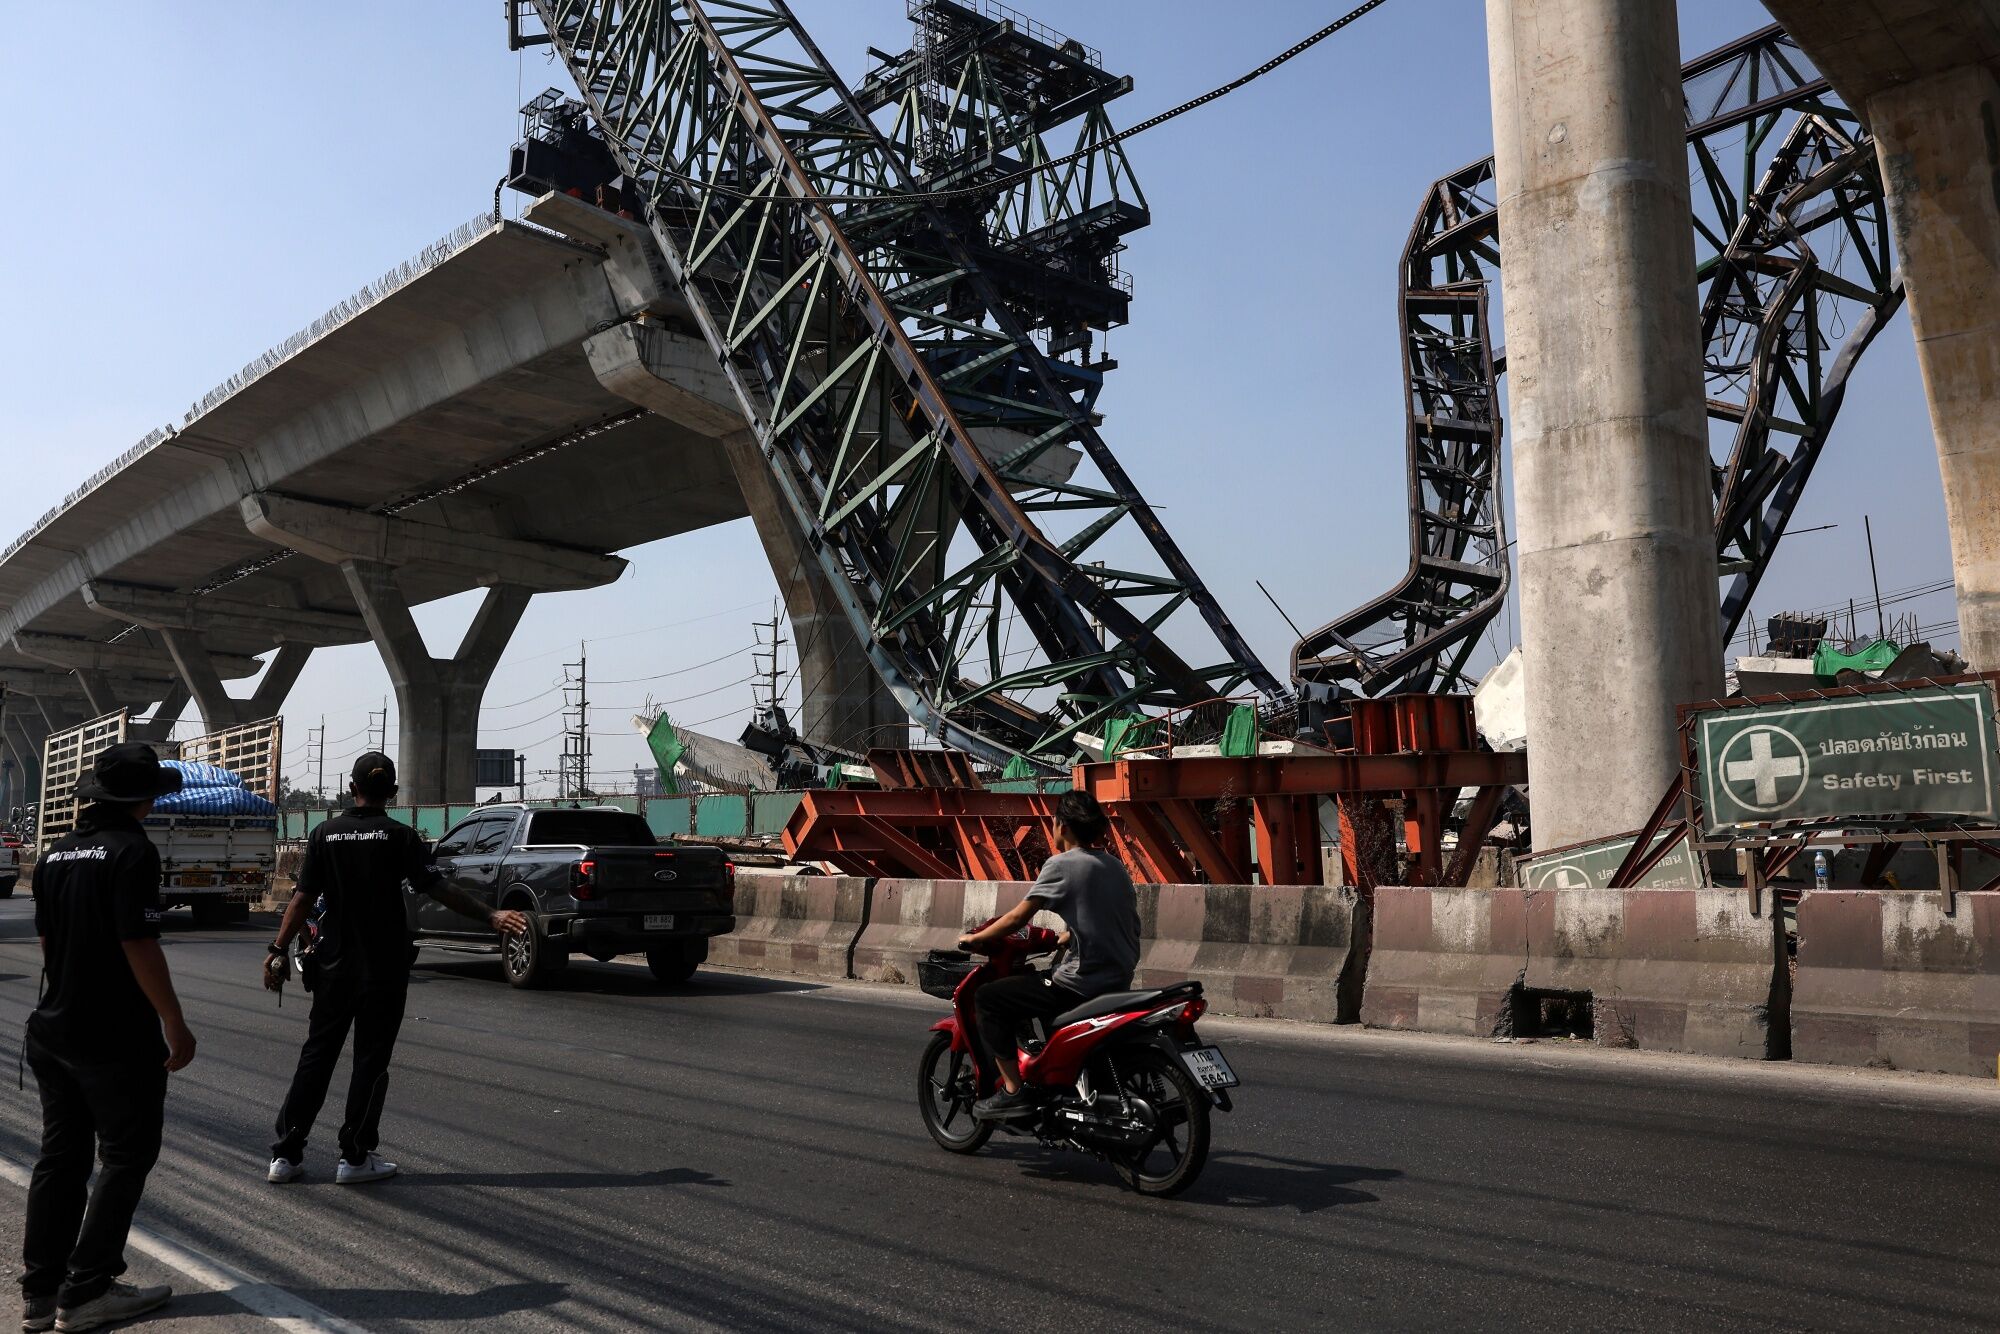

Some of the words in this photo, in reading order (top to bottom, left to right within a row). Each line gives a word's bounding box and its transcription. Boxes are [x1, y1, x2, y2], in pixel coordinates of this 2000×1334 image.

[1819, 724, 1968, 756] ปลอดภัยไว้ก่อน
[1822, 771, 1901, 792] Safety
[1912, 767, 1974, 786] First
[1651, 876, 1688, 889] First
[1200, 1072, 1229, 1084] 5647
